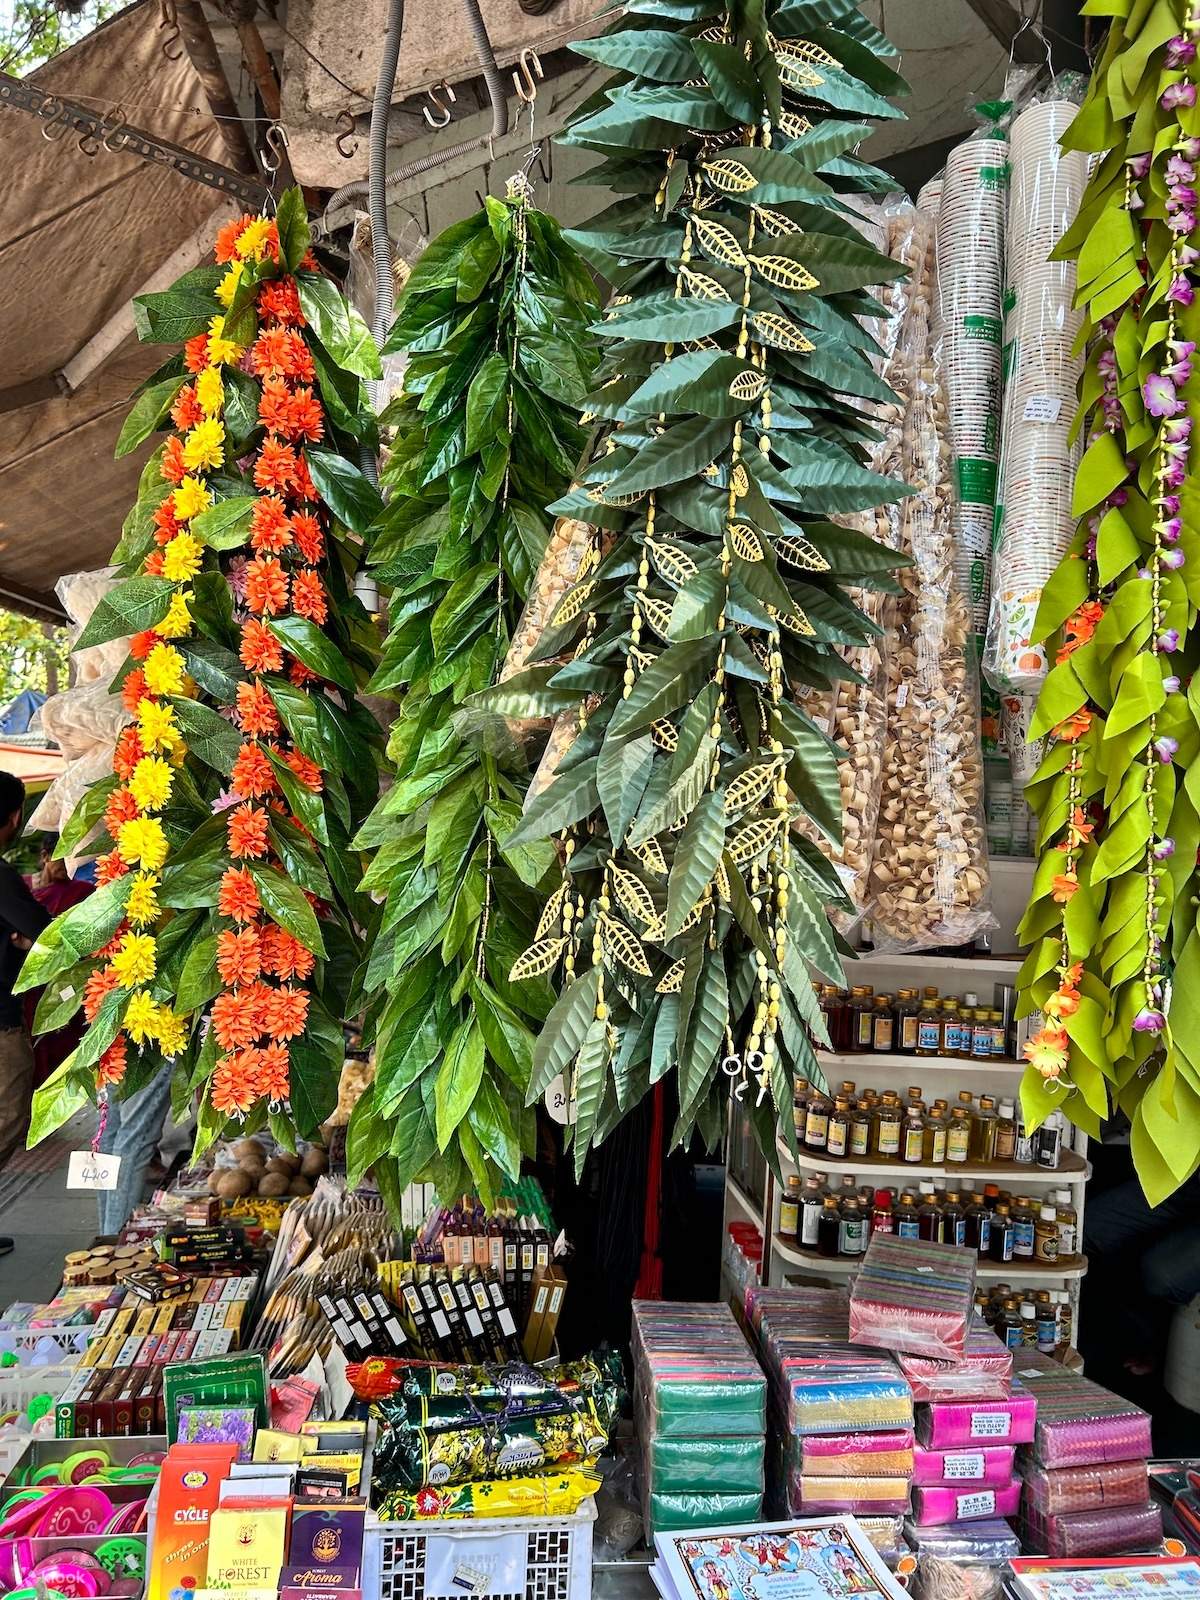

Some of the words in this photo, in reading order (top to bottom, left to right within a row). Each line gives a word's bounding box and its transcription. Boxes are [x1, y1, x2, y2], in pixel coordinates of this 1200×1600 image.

[174, 1508, 209, 1521] CYCLE
[218, 1566, 272, 1581] FOREST
[293, 1570, 343, 1589] Aroma
